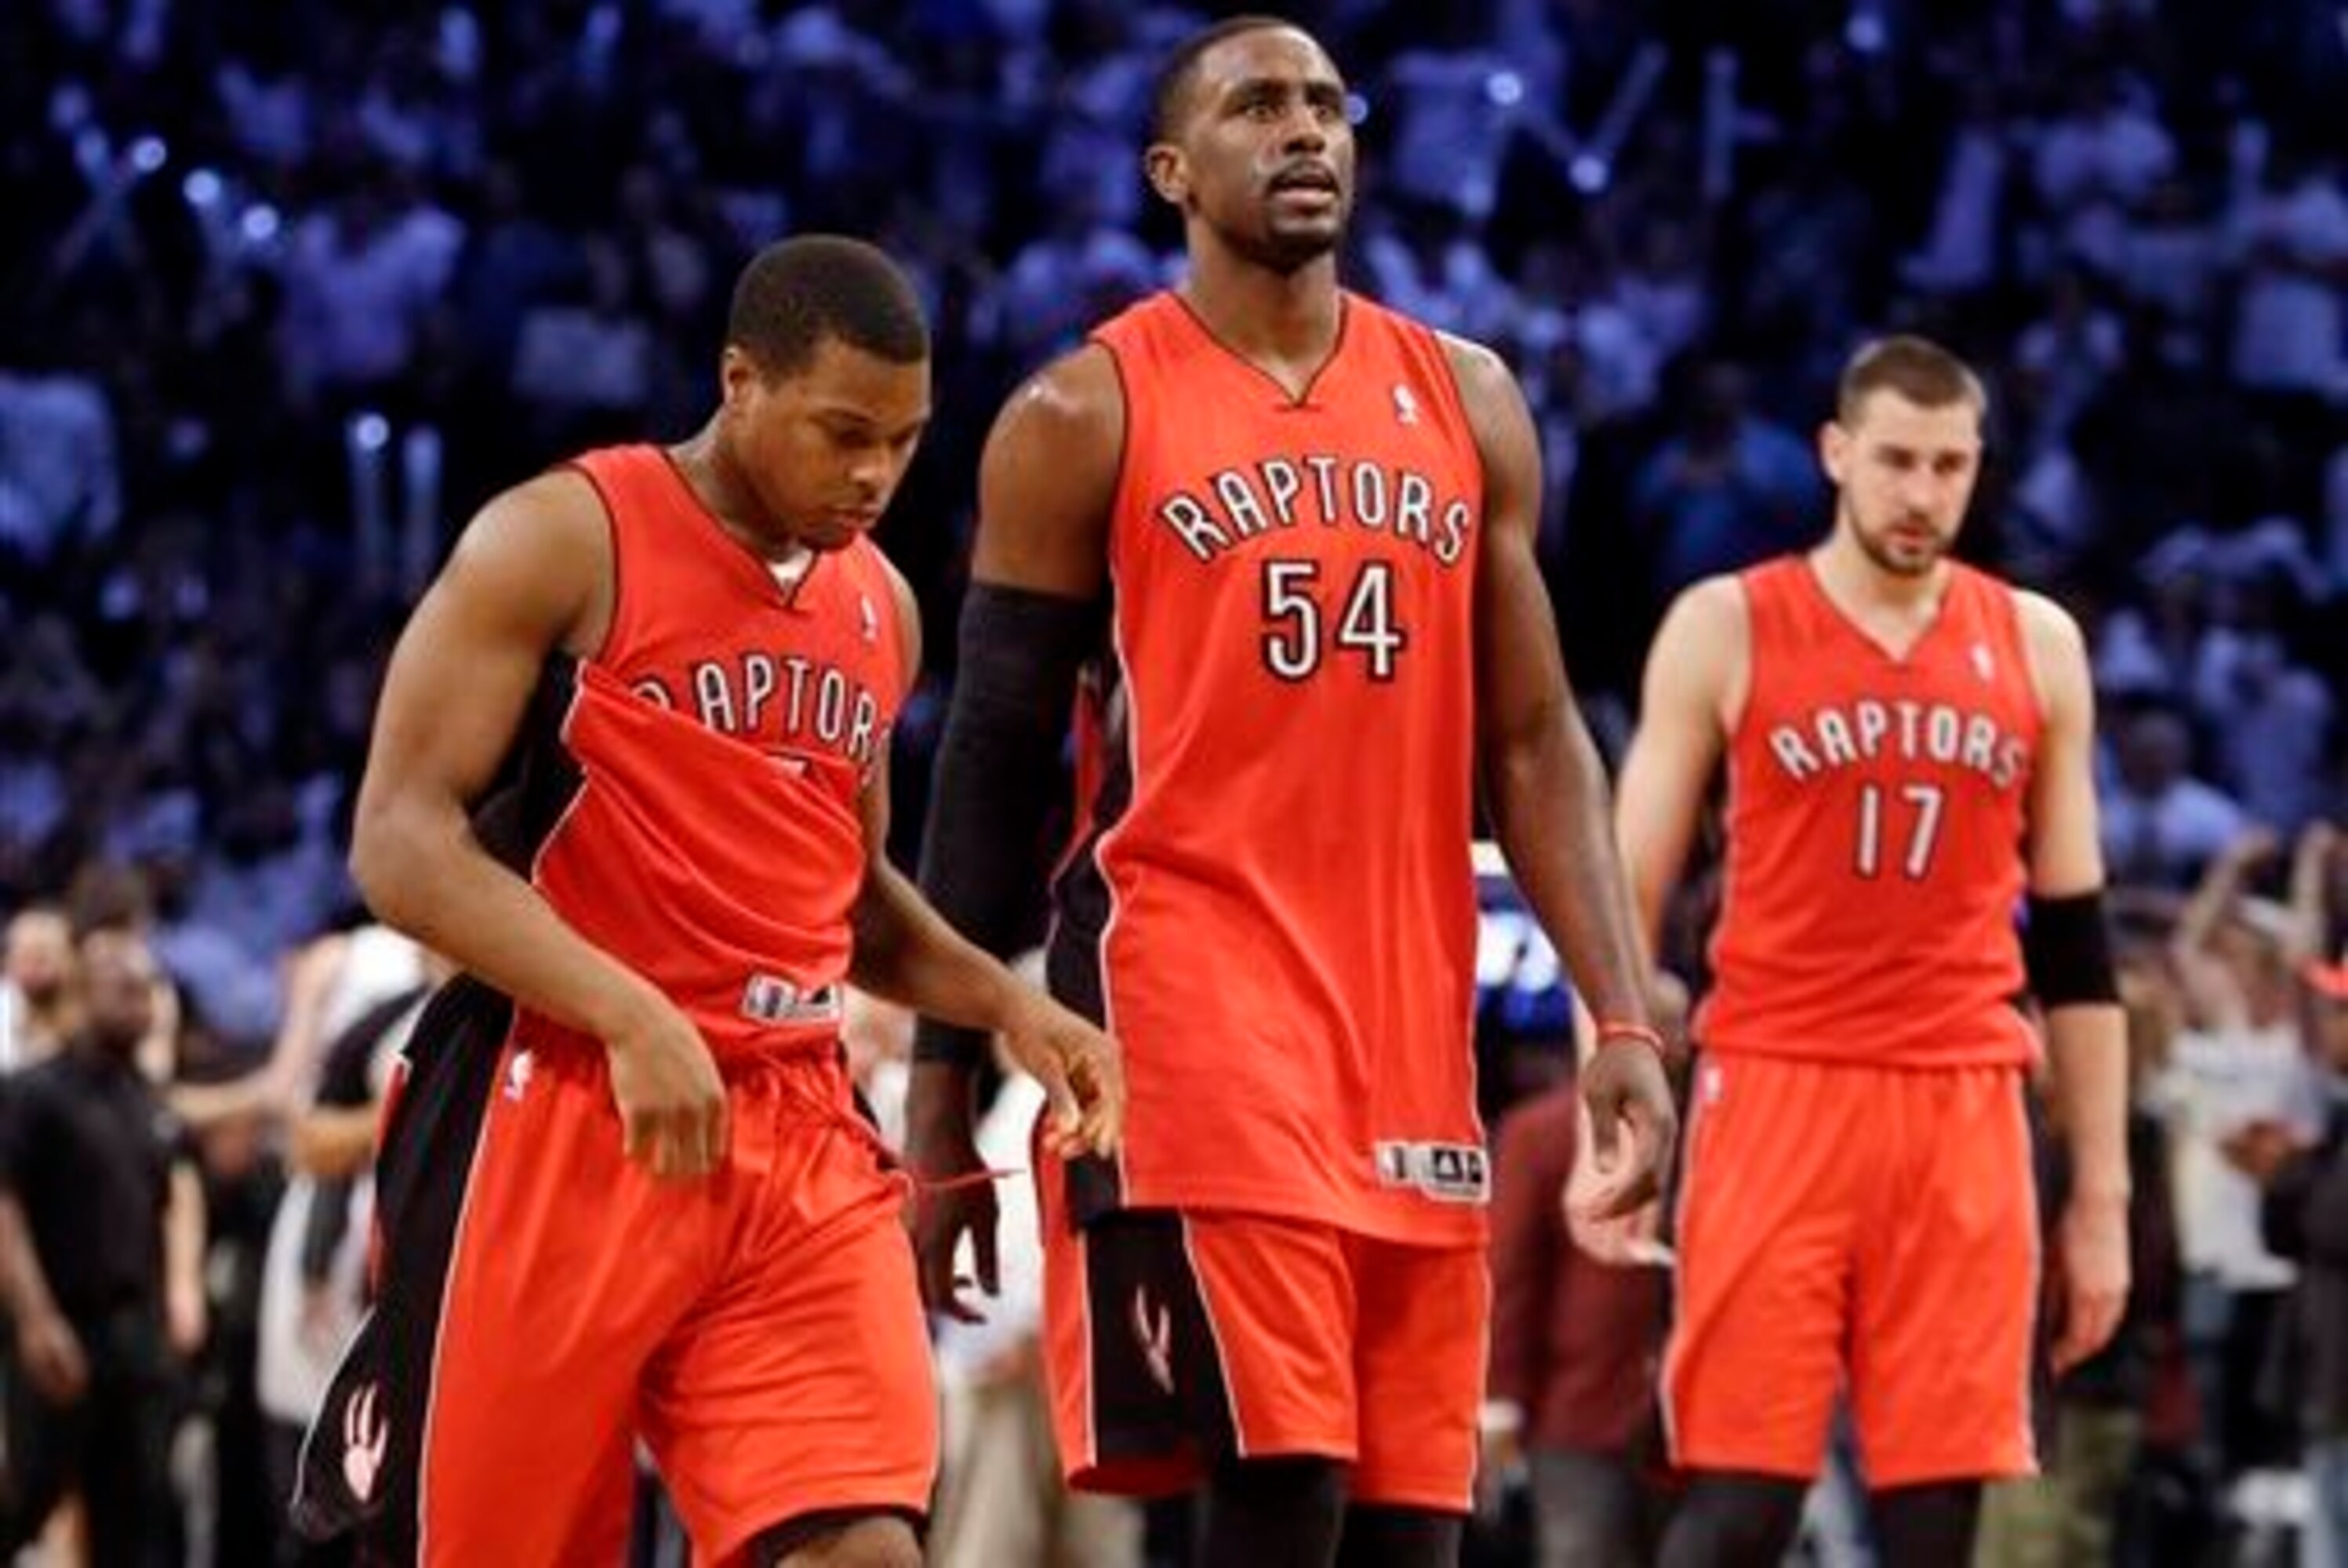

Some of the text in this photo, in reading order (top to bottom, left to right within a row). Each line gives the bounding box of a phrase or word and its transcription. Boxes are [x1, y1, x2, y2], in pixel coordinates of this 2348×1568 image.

[1161, 456, 1470, 564] RAPTORS
[1264, 559, 1403, 679] 54
[629, 653, 892, 786] APTOR
[1768, 700, 2026, 789] RAPTORS
[1858, 785, 1943, 877] 17
